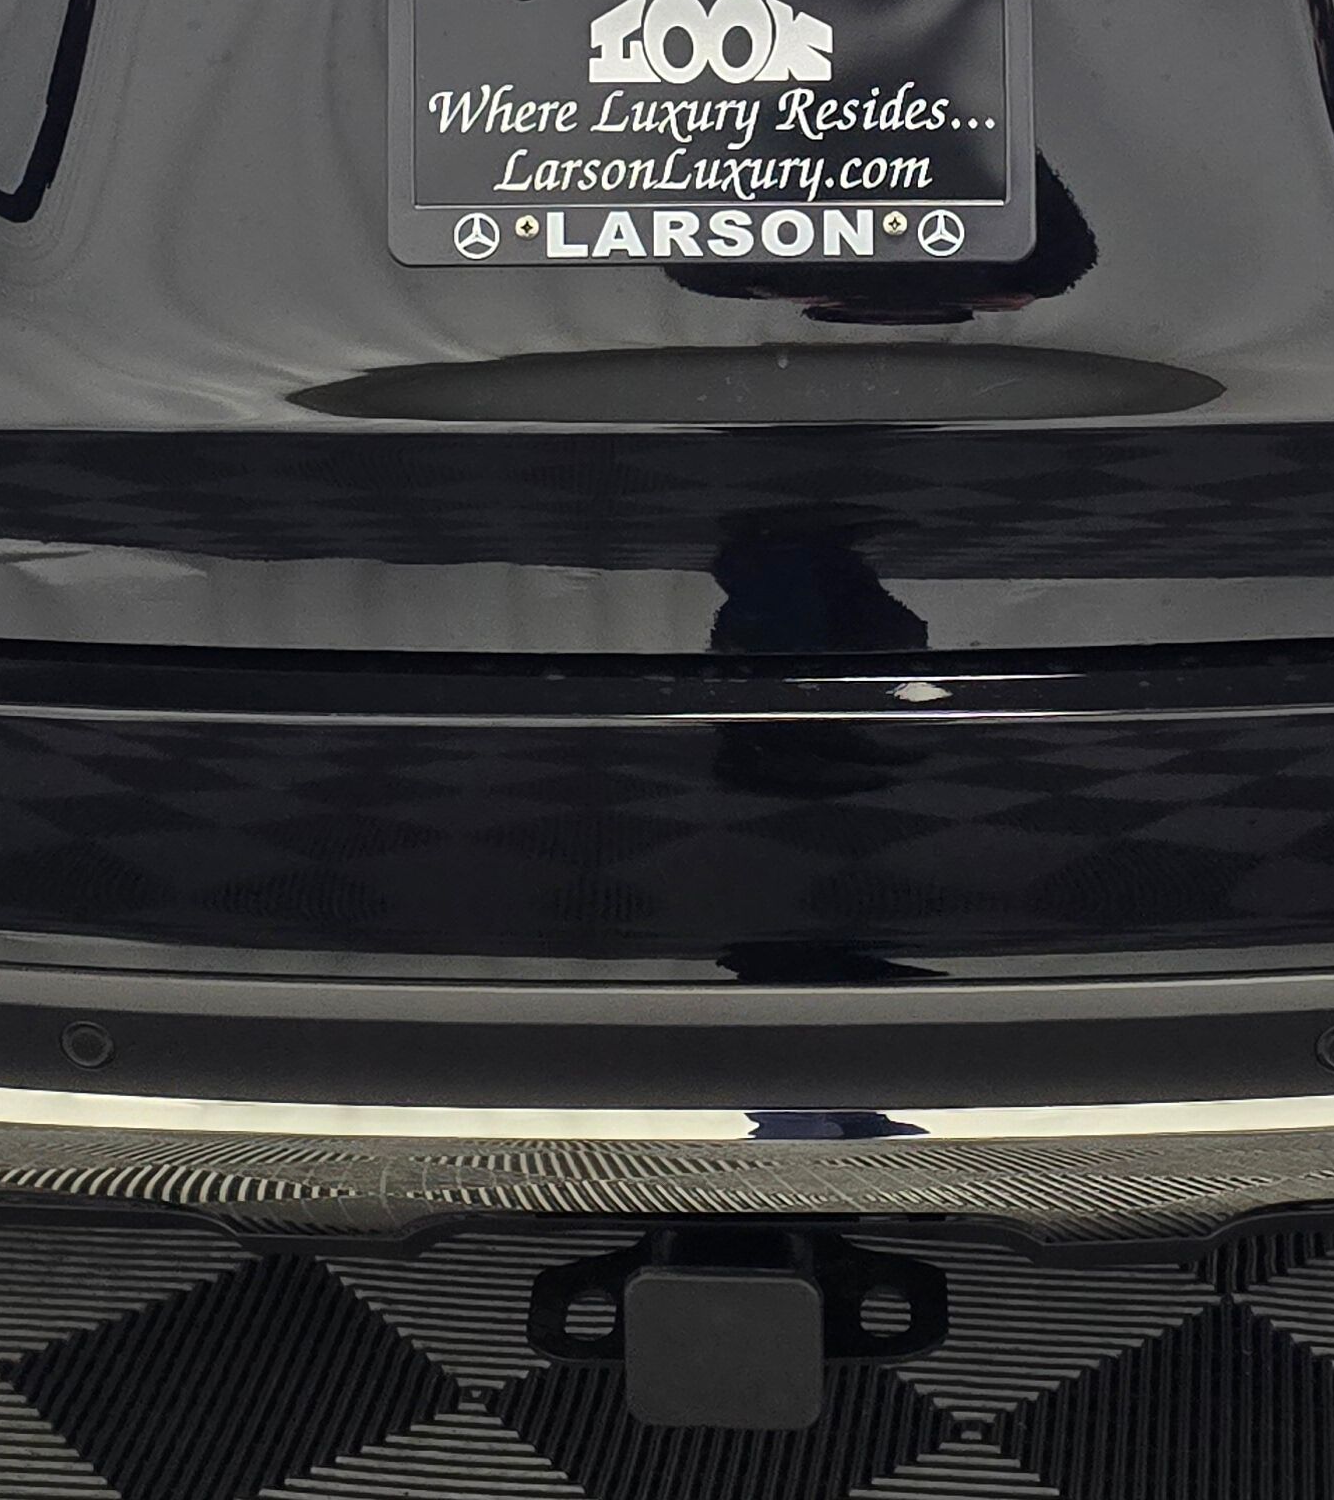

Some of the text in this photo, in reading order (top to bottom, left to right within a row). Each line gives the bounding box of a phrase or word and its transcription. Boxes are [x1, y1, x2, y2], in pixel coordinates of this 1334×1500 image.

[428, 81, 996, 150] Where Luxury Resides...
[493, 148, 933, 201] LarsonLuxury.com
[546, 209, 875, 258] LARSON
